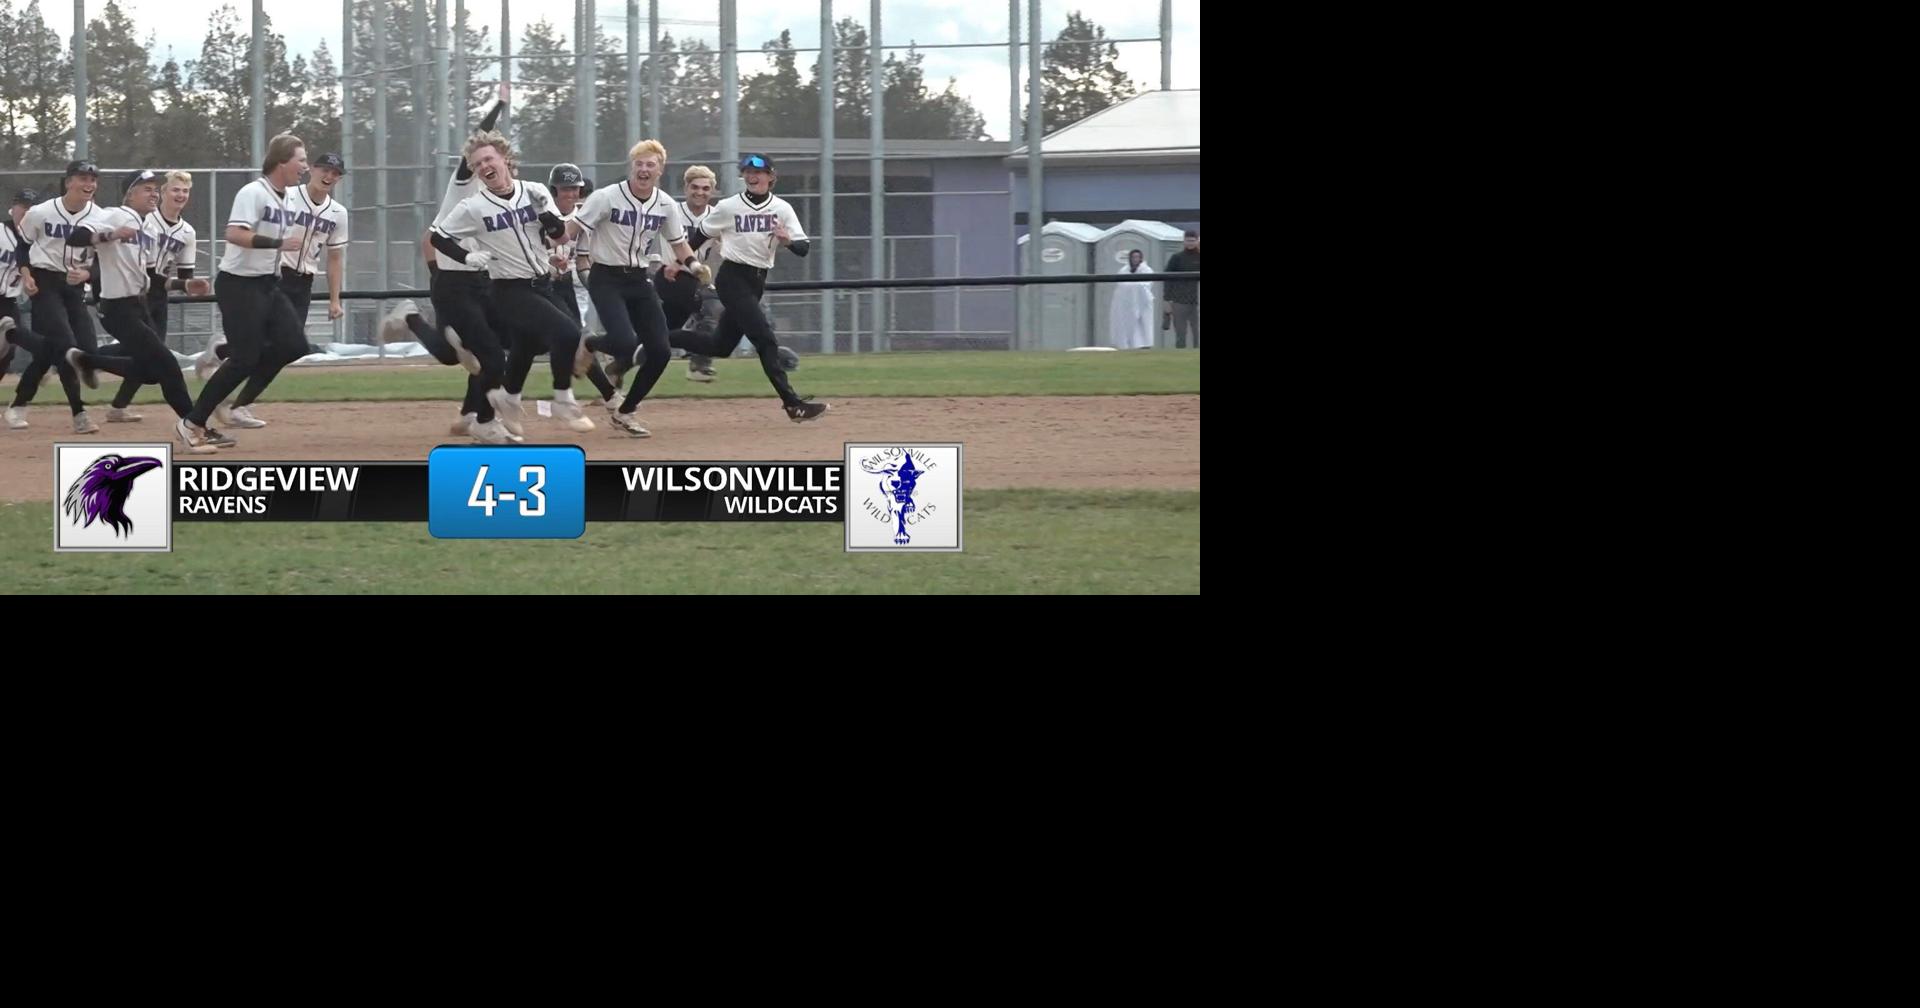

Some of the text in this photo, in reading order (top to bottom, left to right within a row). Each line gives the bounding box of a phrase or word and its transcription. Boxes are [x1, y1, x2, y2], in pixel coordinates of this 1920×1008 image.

[295, 210, 337, 234] AVENS
[482, 205, 538, 232] RAVEN
[734, 213, 778, 233] RAVENS
